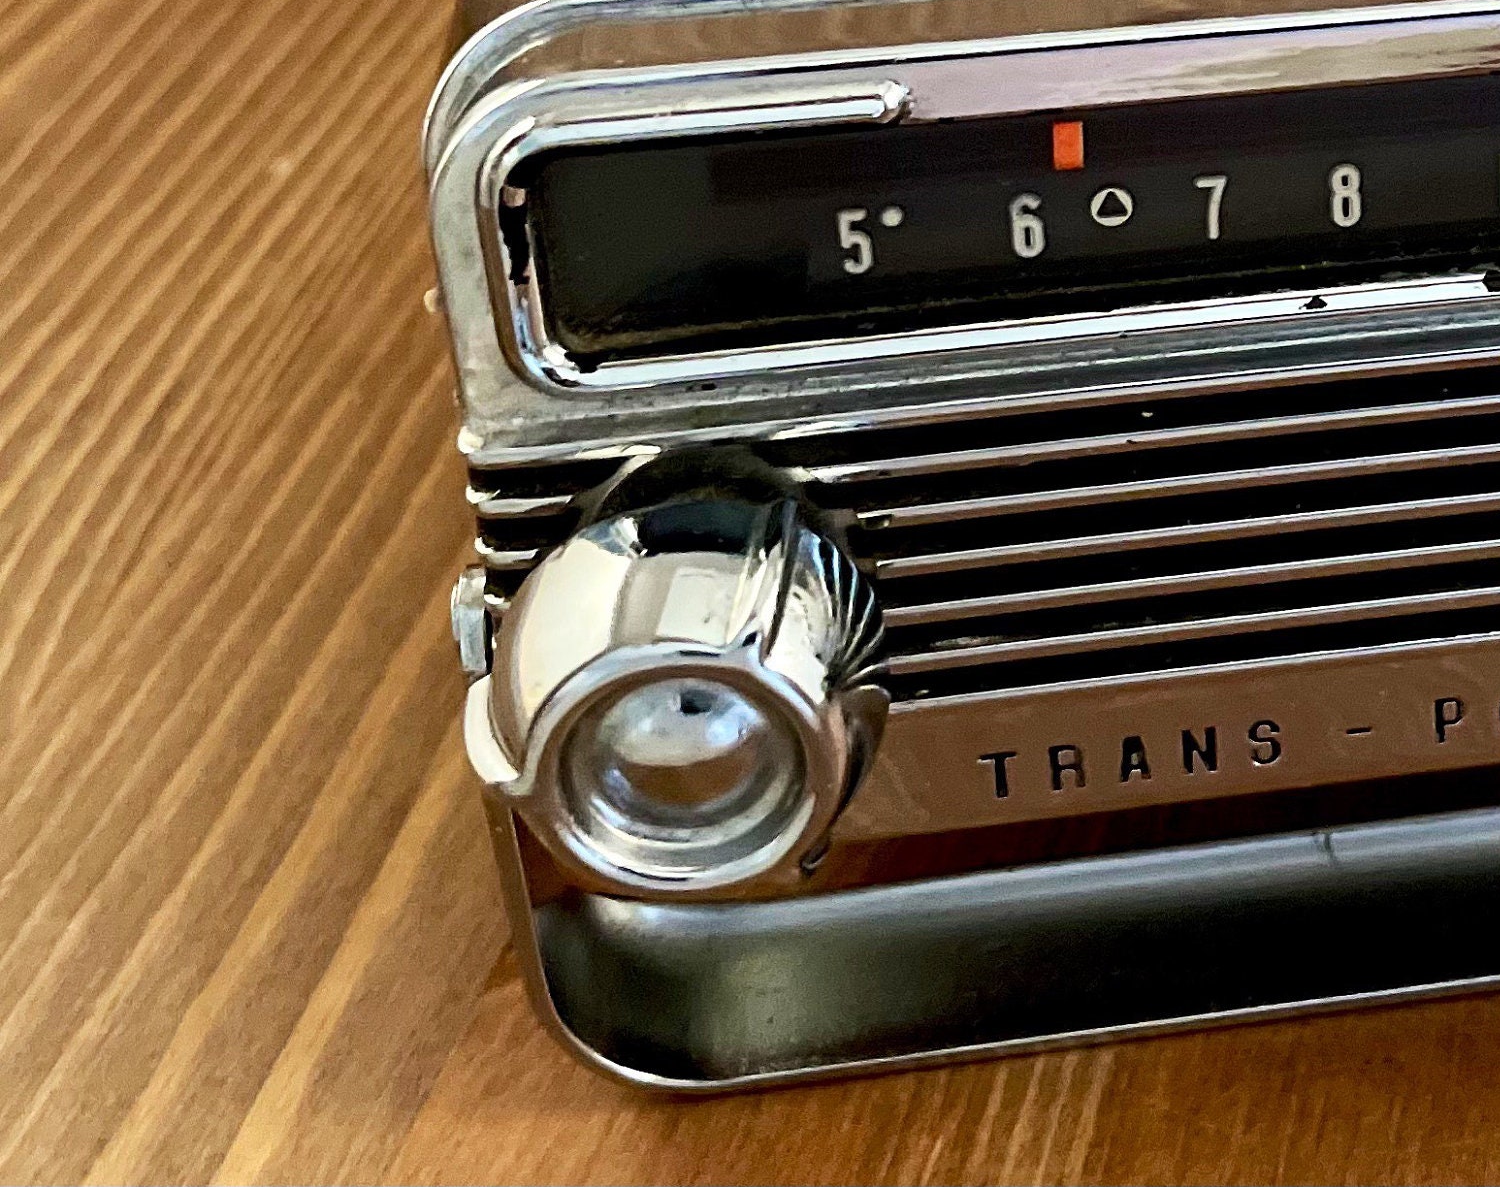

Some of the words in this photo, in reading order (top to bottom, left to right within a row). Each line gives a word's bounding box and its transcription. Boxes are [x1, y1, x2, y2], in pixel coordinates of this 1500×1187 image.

[1009, 191, 1046, 259] 6
[1193, 174, 1229, 241] 7
[1327, 162, 1364, 229] 8
[976, 718, 1284, 800] TRANS
